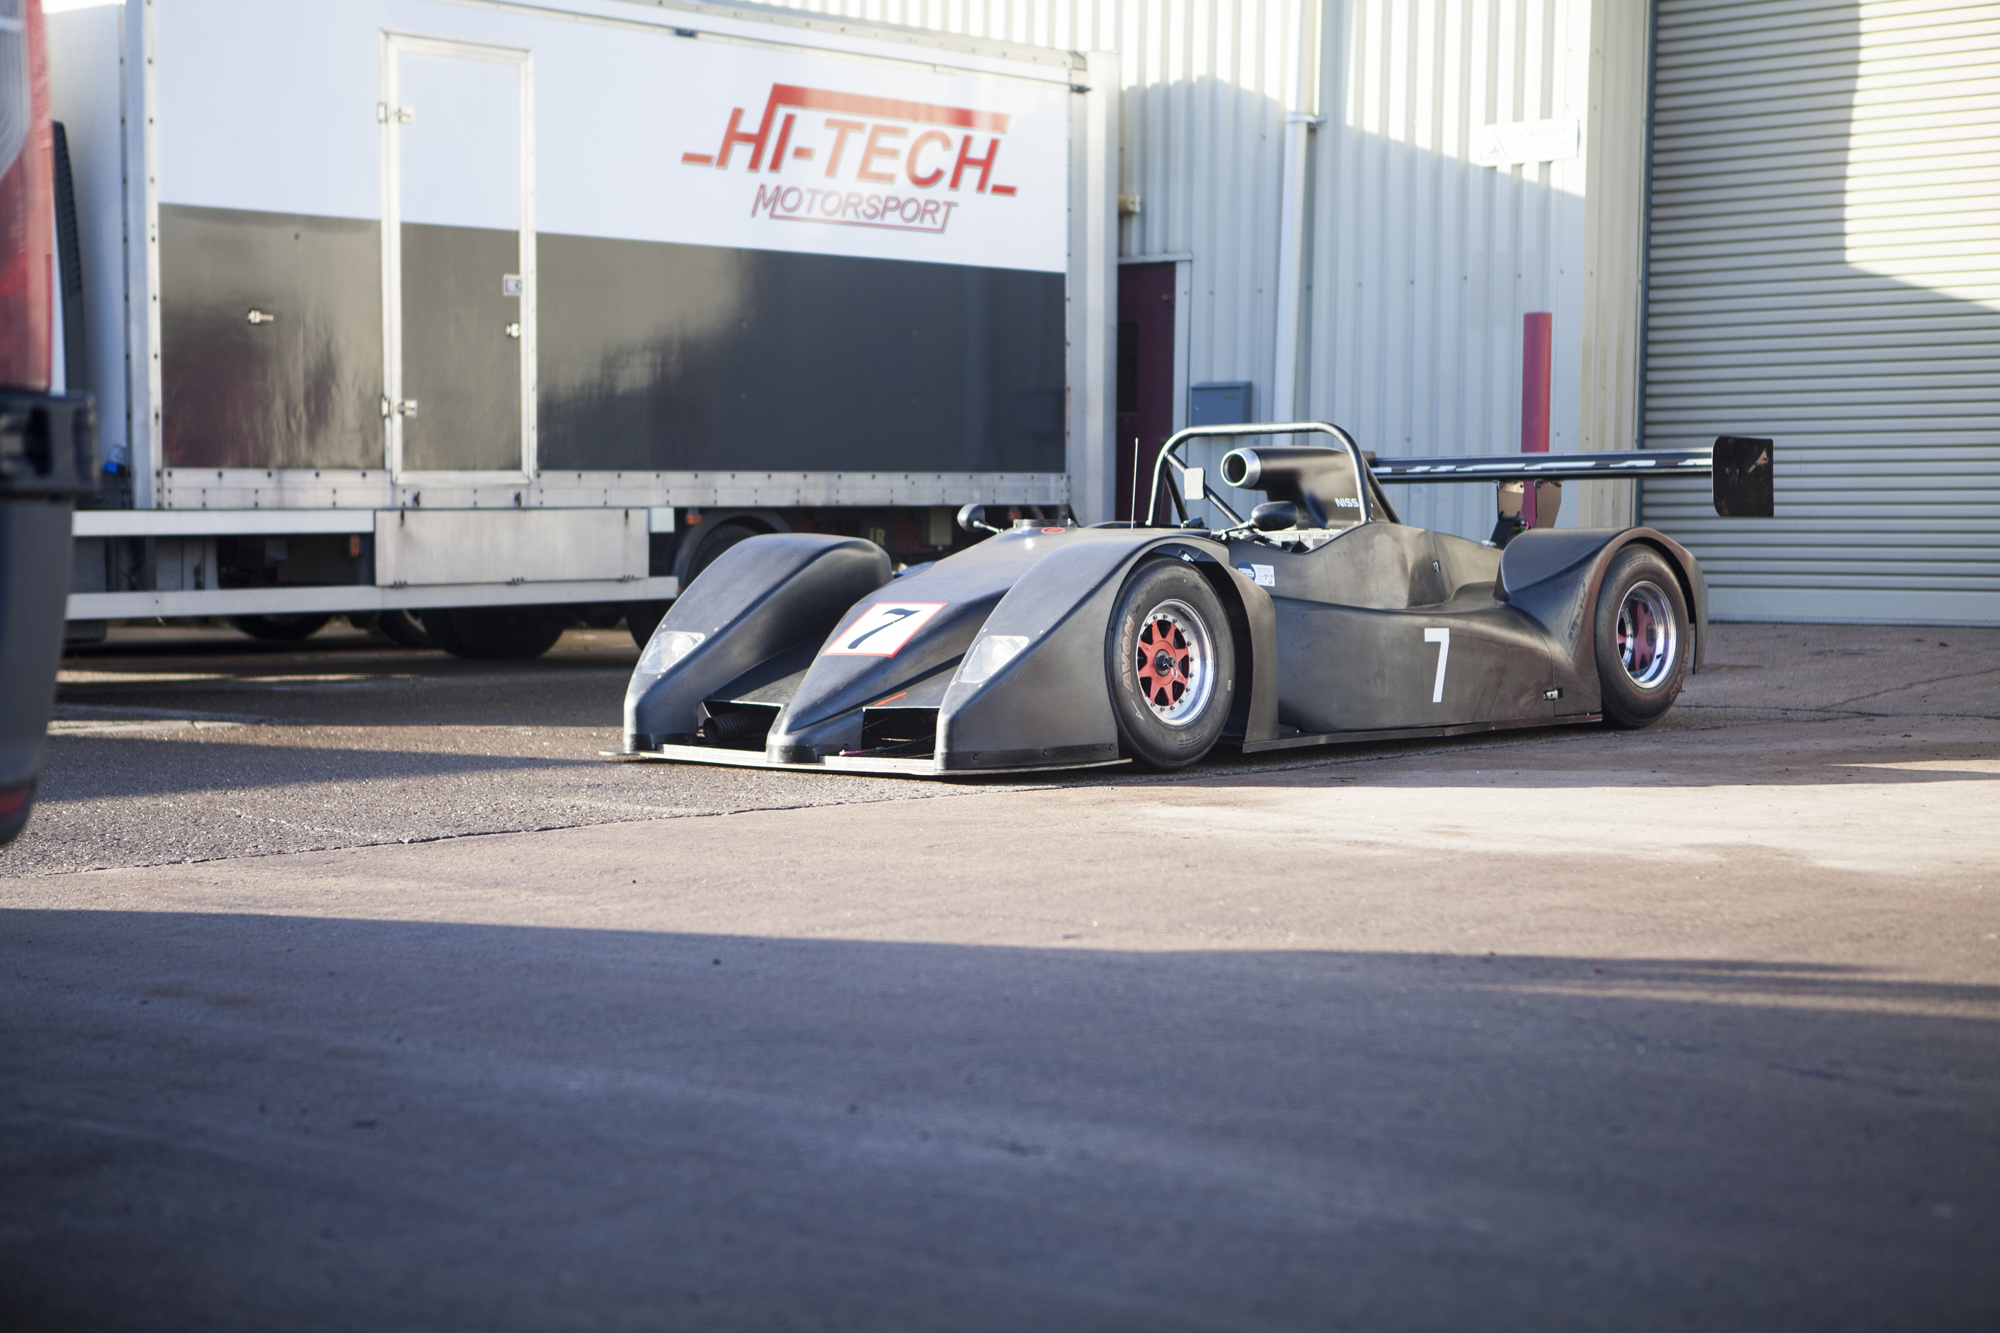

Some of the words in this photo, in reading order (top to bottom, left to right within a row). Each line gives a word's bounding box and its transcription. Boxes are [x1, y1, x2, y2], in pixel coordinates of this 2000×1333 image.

[712, 83, 1011, 195] HI-TECH
[751, 184, 958, 233] MOTORSPORT
[1334, 497, 1374, 508] NISS
[847, 608, 922, 650] 7
[1121, 615, 1135, 693] AVON
[1424, 627, 1450, 703] 7
